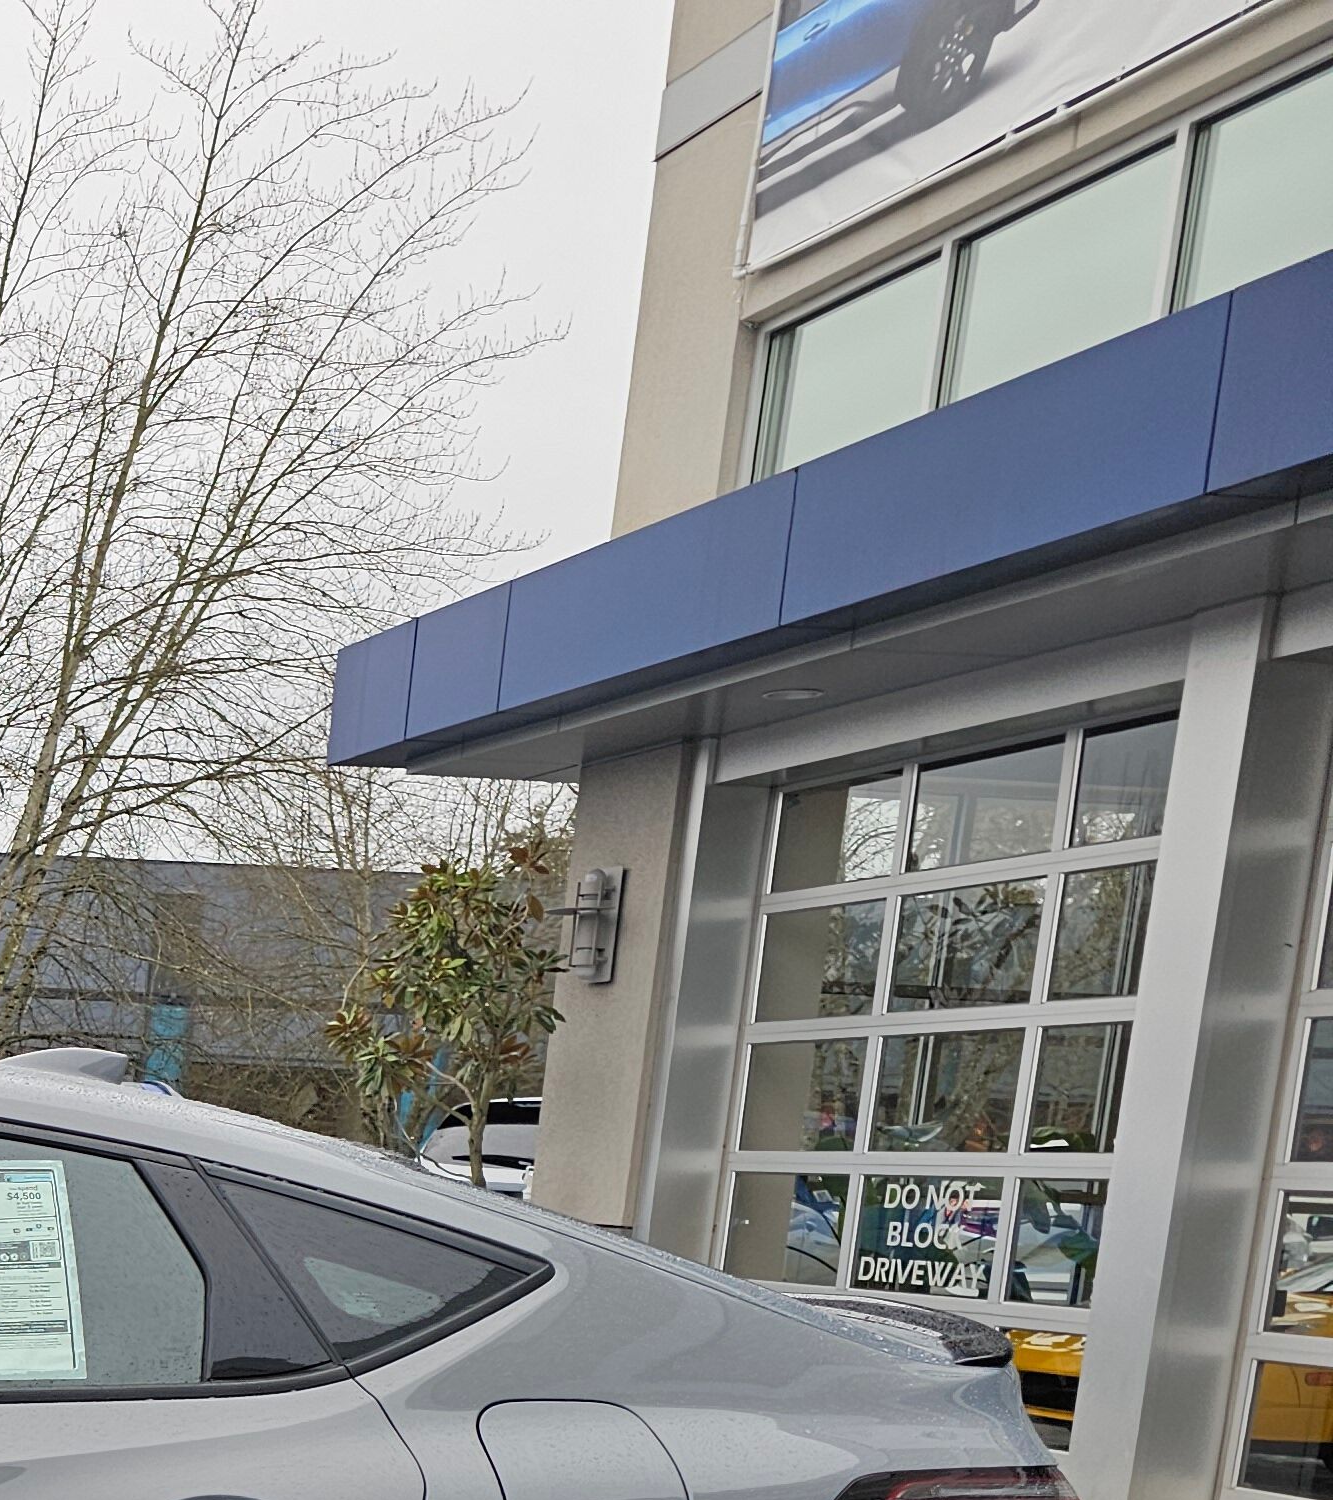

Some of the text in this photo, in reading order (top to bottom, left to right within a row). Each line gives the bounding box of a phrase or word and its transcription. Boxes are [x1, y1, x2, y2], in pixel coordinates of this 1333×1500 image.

[6, 1192, 42, 1201] $4,500
[883, 1183, 981, 1211] DO NOT
[886, 1221, 964, 1249] BLOCK
[857, 1256, 986, 1290] DRIVEWAY
